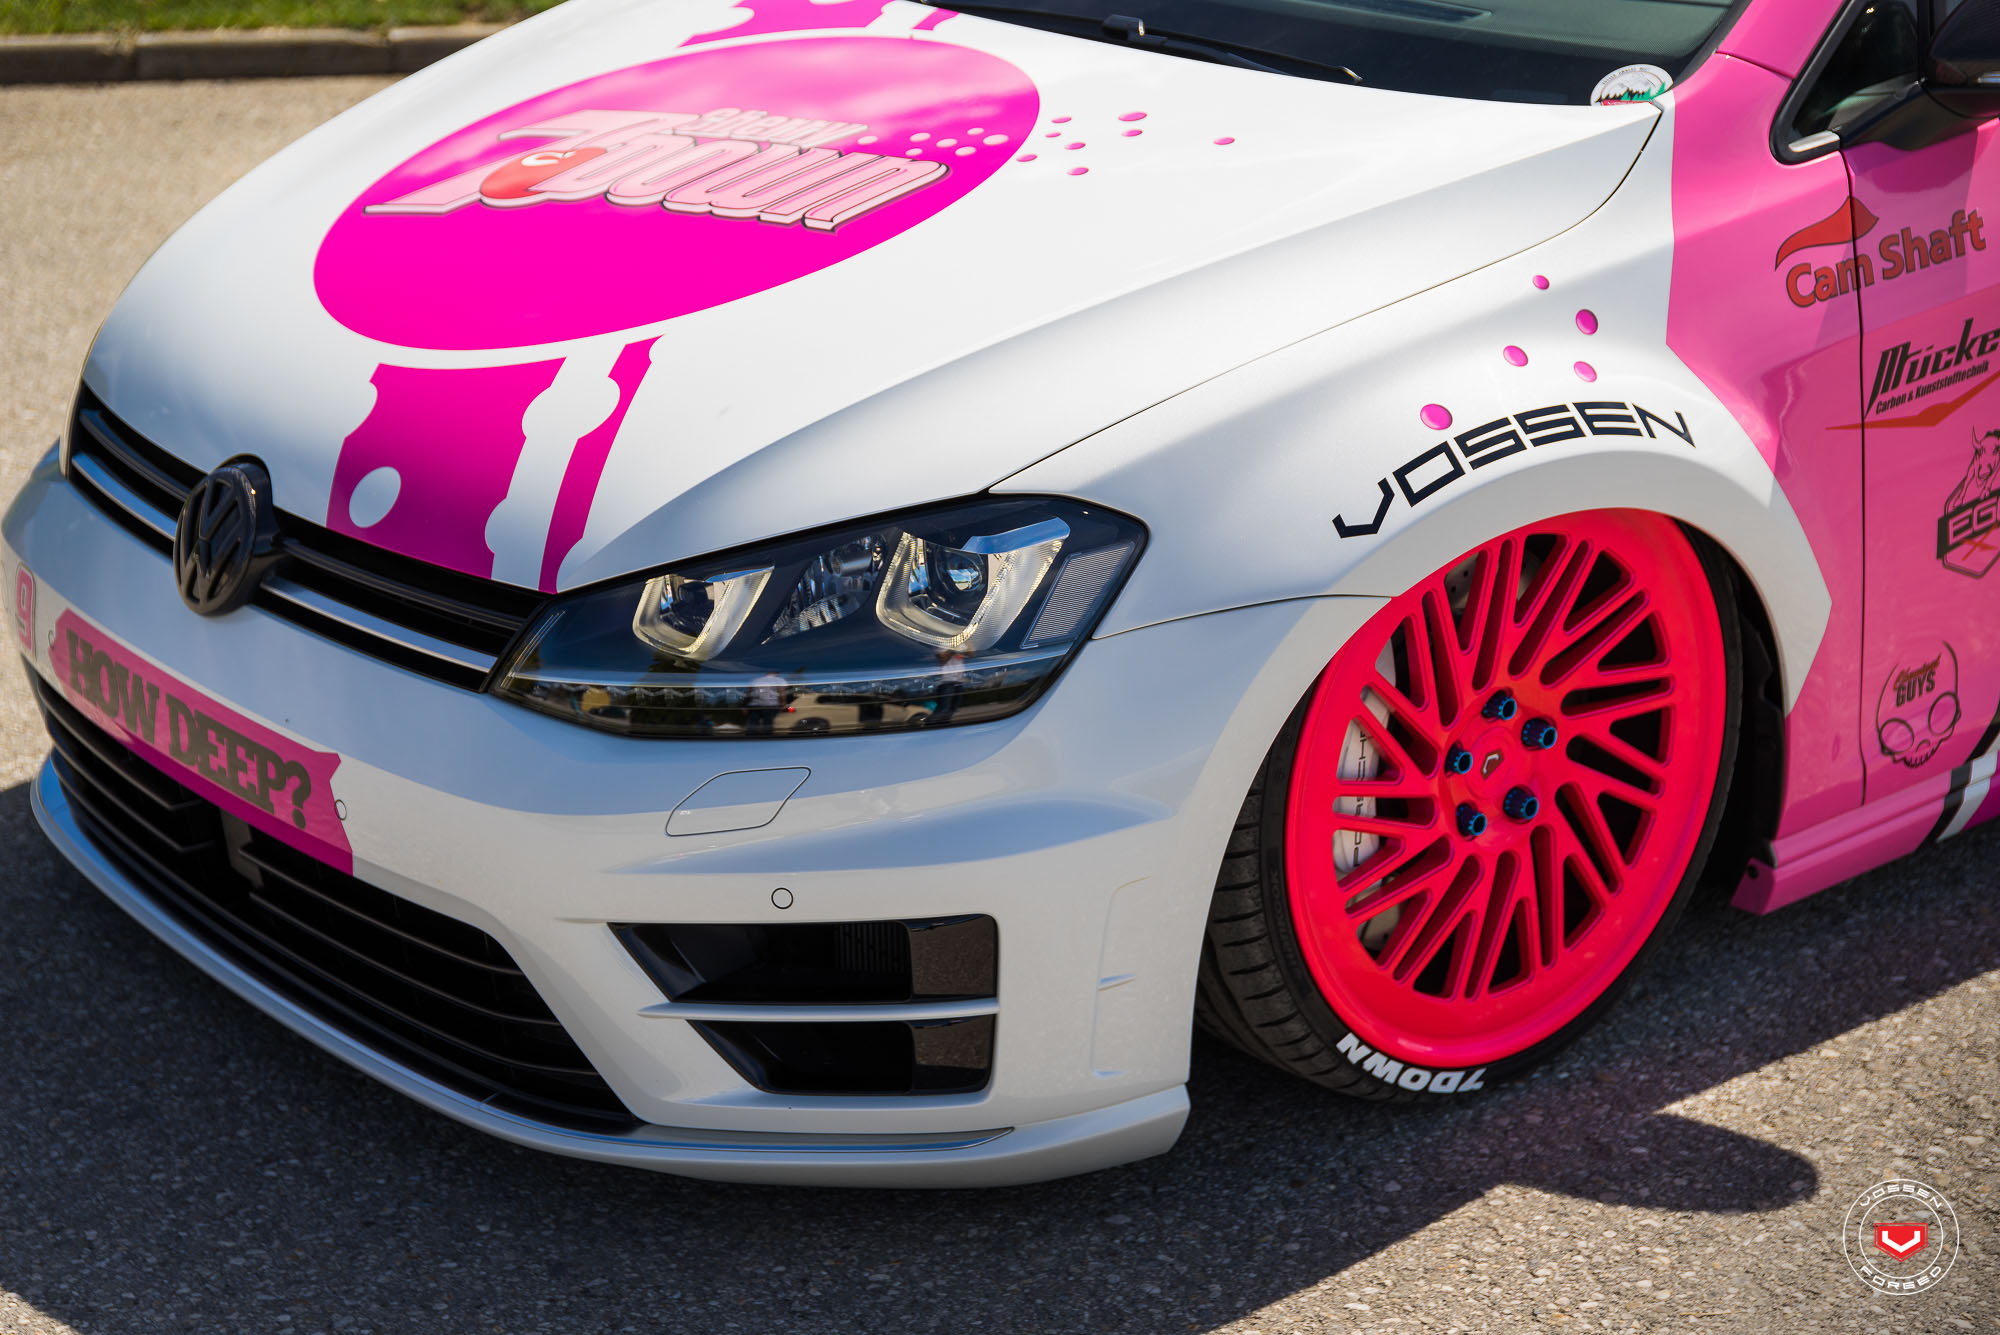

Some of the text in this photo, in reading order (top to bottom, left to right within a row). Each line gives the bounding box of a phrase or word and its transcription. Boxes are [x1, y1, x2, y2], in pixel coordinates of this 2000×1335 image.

[1785, 209, 1987, 308] Cam Shaft
[1875, 390, 1907, 415] Carbon
[1332, 401, 1696, 539] VOSSEN
[1948, 495, 2000, 546] EG
[1896, 669, 1936, 707] GUYS
[66, 628, 312, 830] HOW DEEP?
[1336, 1032, 1487, 1093] 7DOWN
